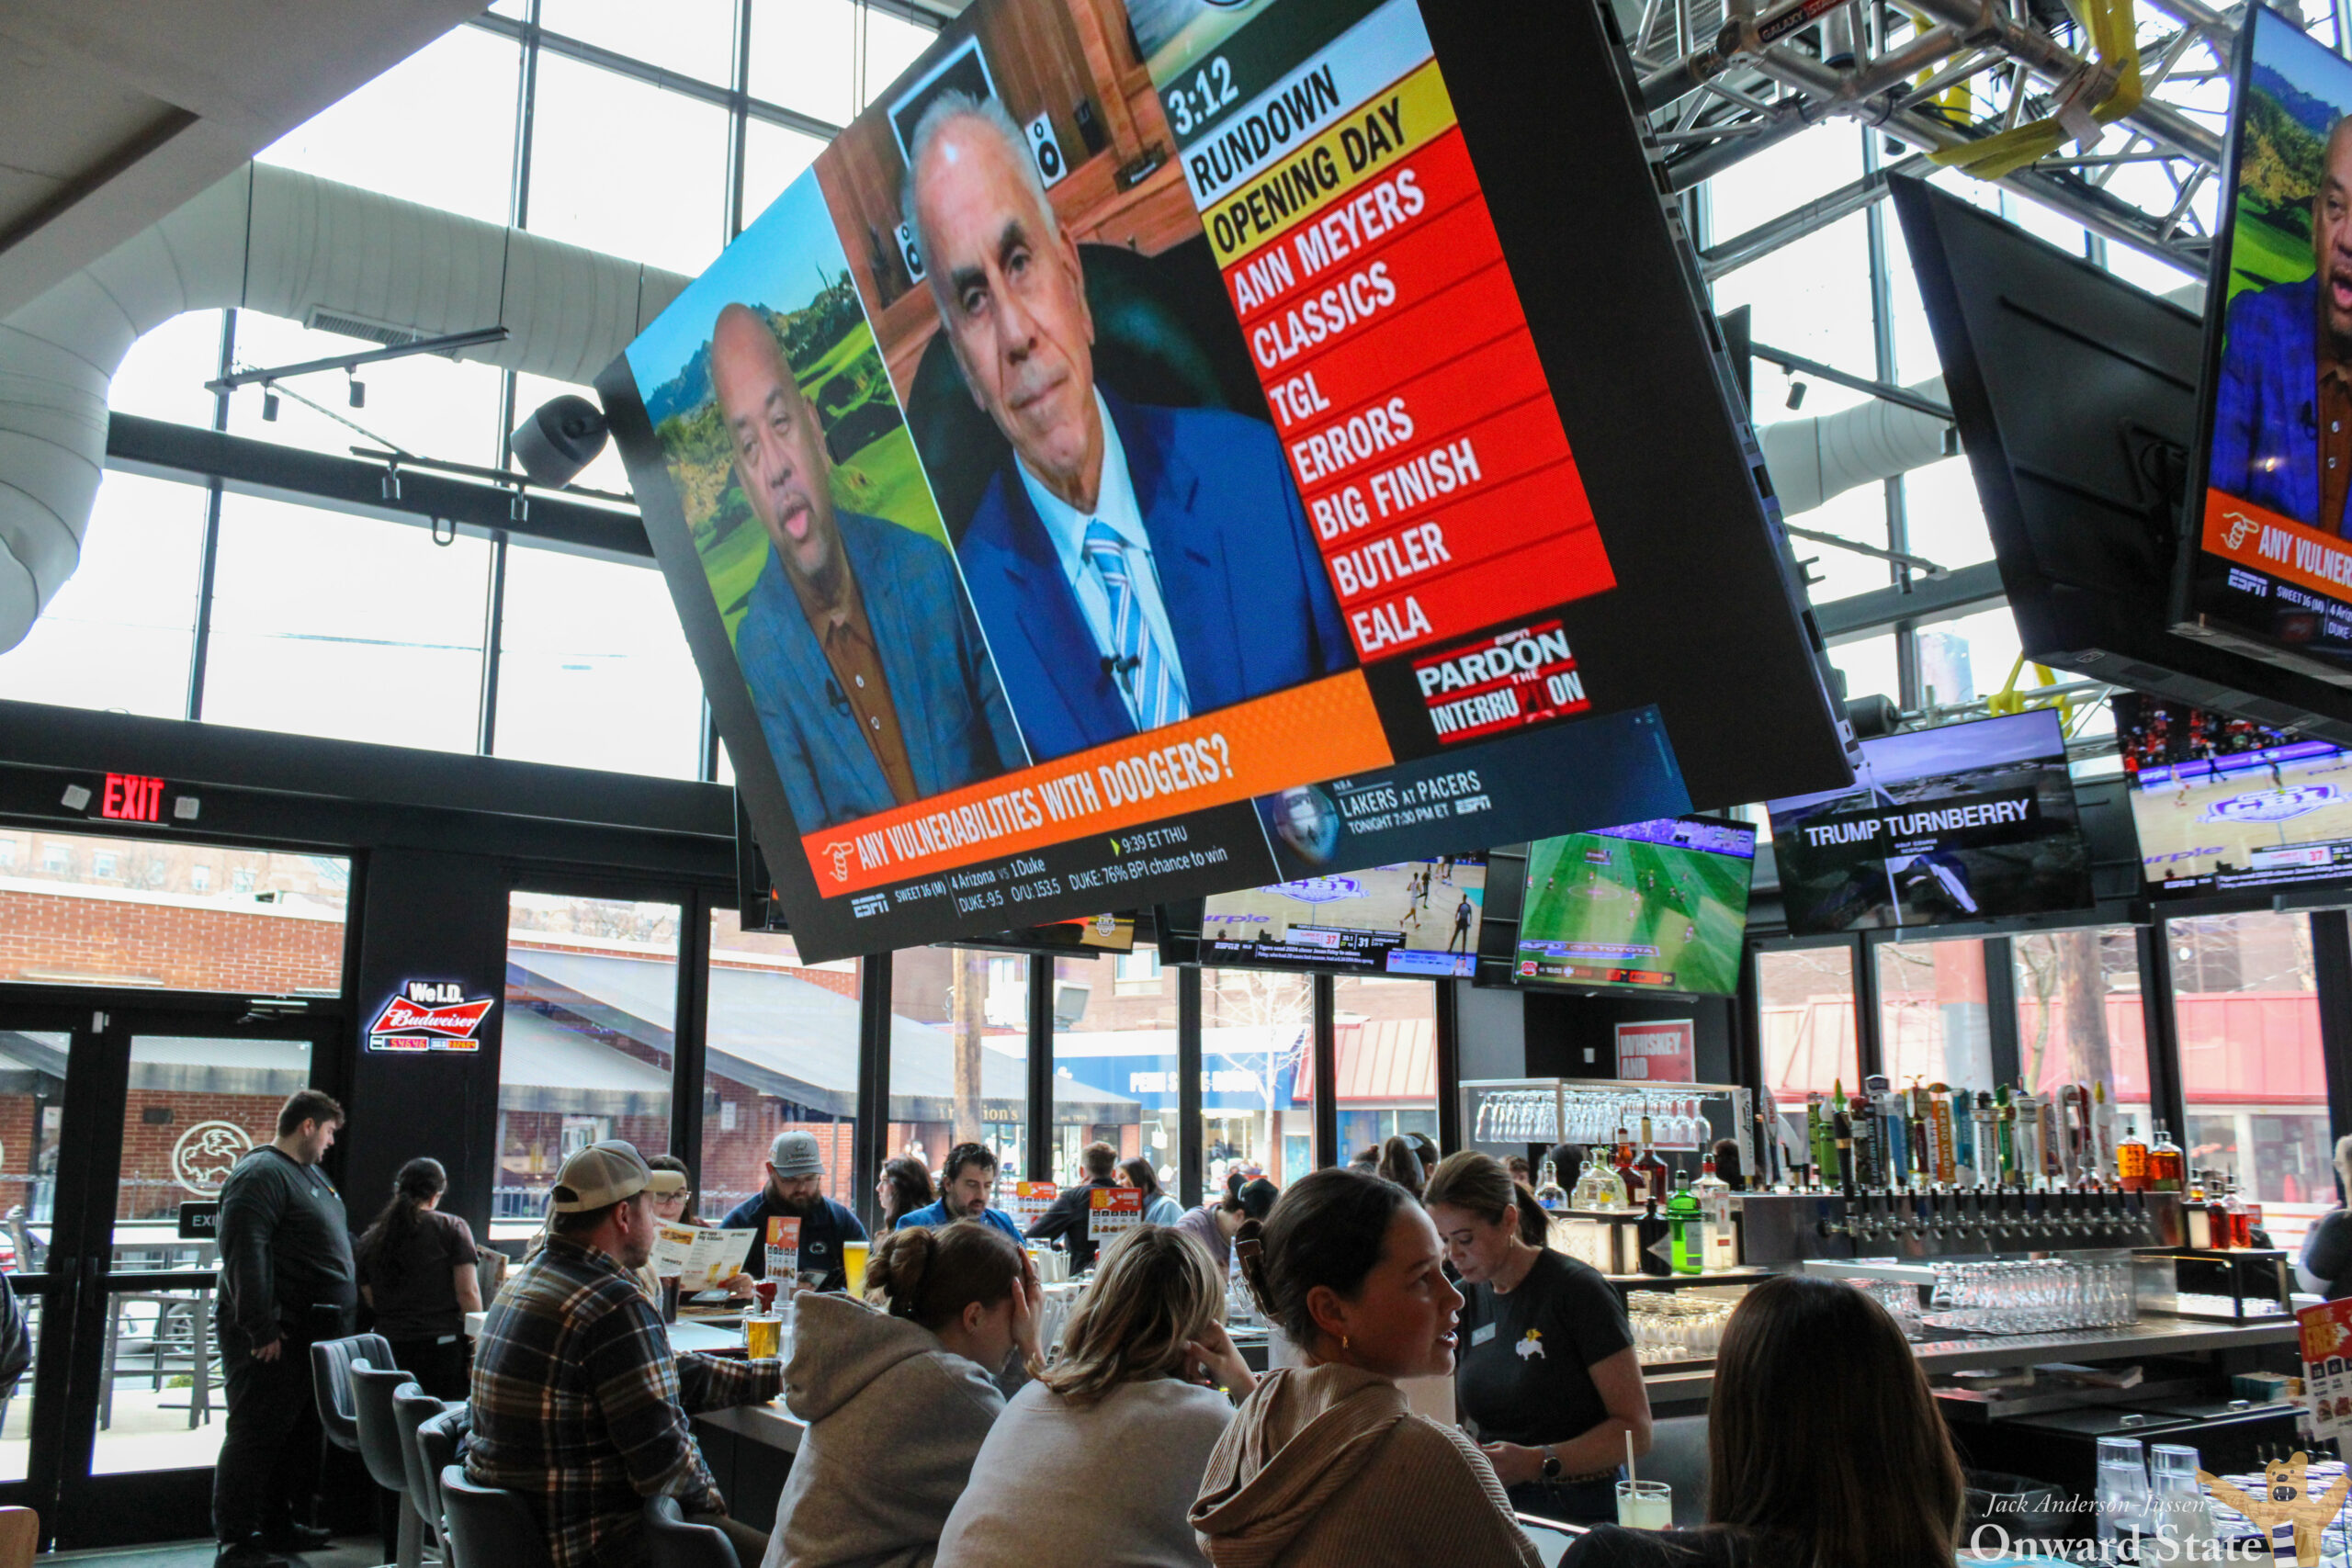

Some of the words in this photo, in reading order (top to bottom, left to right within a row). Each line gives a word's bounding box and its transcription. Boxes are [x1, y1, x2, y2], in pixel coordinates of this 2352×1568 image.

[1169, 56, 1238, 135] 3:12
[1192, 64, 1340, 197] RUNDOWN
[1214, 146, 1340, 254] OPENING
[1341, 97, 1406, 173] DAY
[1234, 245, 1295, 314] ANN
[1295, 169, 1426, 277] MEYERS
[1252, 261, 1396, 368] CLASSICS
[1270, 371, 1330, 426] TGL
[1292, 397, 1414, 484] ERRORS
[1312, 486, 1370, 540] BIG
[1370, 438, 1481, 517] FINISH
[1331, 522, 1452, 597] BUTLER
[2258, 525, 2293, 563] ANY
[2228, 567, 2268, 597] ESPN
[2277, 585, 2302, 604] SWEET
[1351, 596, 1432, 652] EALA
[1416, 628, 1572, 698] PARDON
[1510, 670, 1541, 685] THE
[102, 773, 164, 821] EXIT
[855, 831, 888, 872] ANY
[886, 788, 1044, 863] VULNERABILITIES
[1039, 769, 1098, 820] WITH
[1099, 733, 1235, 808] DODGERS?
[1340, 788, 1398, 818] LAKERS
[1402, 789, 1417, 806] AT
[1417, 770, 1482, 802] PACERS
[1347, 816, 1394, 835] TONIGHT
[1416, 807, 1435, 822] PM
[1435, 802, 1451, 818] ET
[1454, 795, 1492, 815] ESPN
[1121, 834, 1148, 854] 9:39
[1148, 829, 1164, 848] ET
[1163, 825, 1188, 845] THU
[1805, 819, 1882, 846] TRUMP
[1884, 798, 2030, 837] TURNBERRY
[894, 886, 920, 903] SWEET
[920, 885, 932, 897] 16
[932, 881, 946, 897] (M)
[951, 876, 958, 890] 4
[958, 870, 996, 889] Arizona
[1011, 862, 1019, 878] 1
[1019, 857, 1046, 875] Duke
[958, 894, 986, 913] DUKE
[986, 890, 1004, 908] -9.5
[1011, 882, 1035, 902] O/U:
[1035, 878, 1061, 897] 153.5
[1069, 870, 1102, 891] DUKE:
[1102, 864, 1128, 885] 76%
[1127, 860, 1149, 880] BPI
[1149, 852, 1191, 875] chance
[1191, 849, 1205, 867] to
[1204, 847, 1228, 865] win
[851, 893, 890, 919] ESPN
[1325, 935, 1338, 944] 37
[1597, 945, 1654, 953] TOYOTA
[409, 982, 435, 1002] We
[386, 1009, 478, 1027] Budweiser
[1620, 1032, 1682, 1056] WHISKEY
[1622, 1057, 1648, 1079] AND
[192, 1214, 217, 1227] EXI
